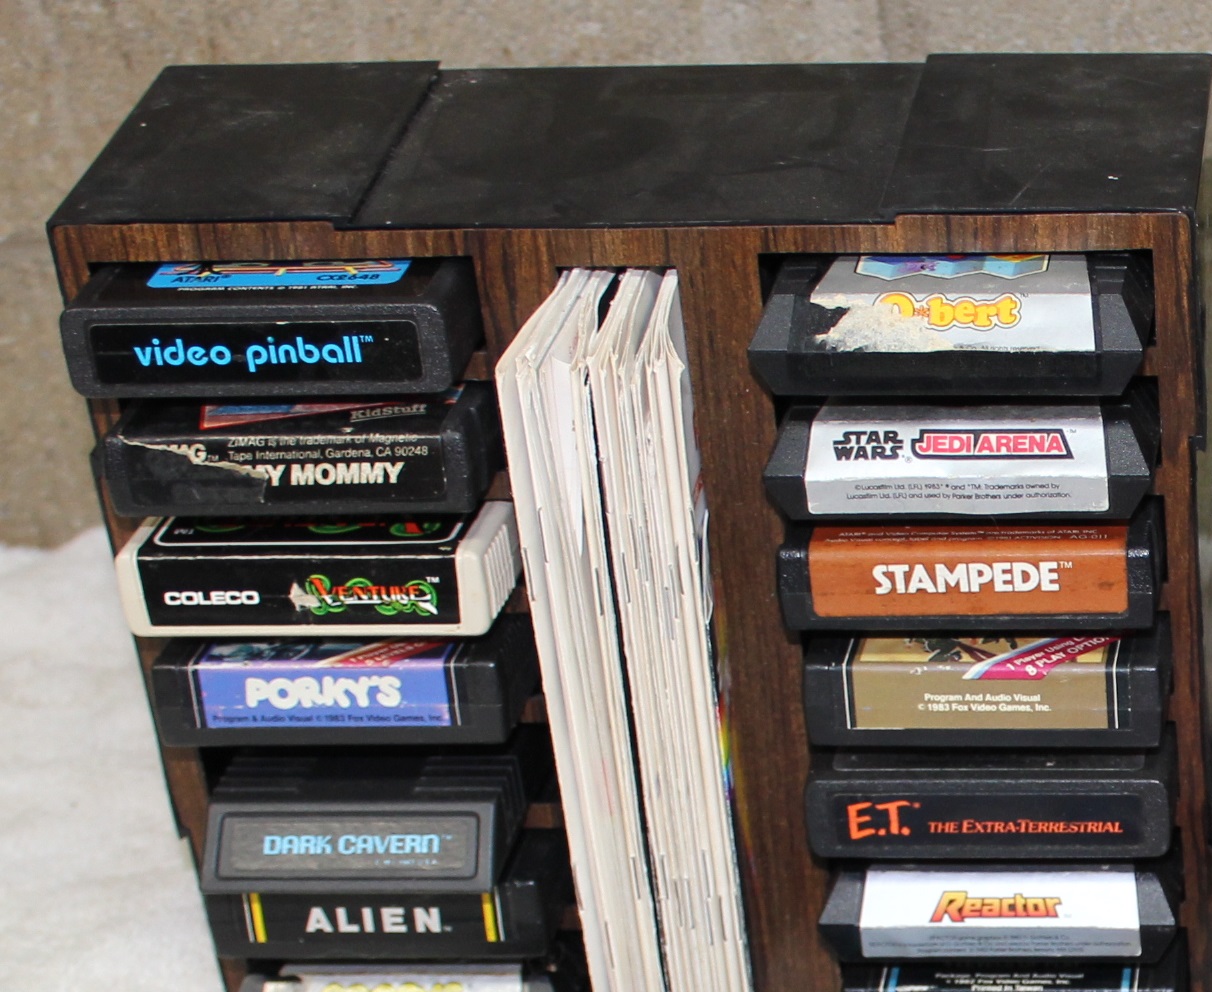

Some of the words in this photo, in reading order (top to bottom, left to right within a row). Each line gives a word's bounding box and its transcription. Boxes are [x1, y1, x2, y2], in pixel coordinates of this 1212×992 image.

[134, 338, 232, 366] video
[350, 404, 426, 421] KidStuff
[834, 430, 903, 445] STAR
[915, 433, 972, 454] JEDI
[977, 433, 1065, 454] ARENA
[375, 447, 392, 457] CA
[395, 445, 428, 456] 90248
[833, 446, 904, 460] WARS
[291, 462, 404, 485] MOMMY
[164, 591, 260, 604] COLECO
[245, 676, 401, 709] PORKY'S
[924, 693, 963, 702] Program
[965, 693, 983, 702] And
[985, 693, 1012, 702] Audio
[1013, 693, 1040, 702] Visual
[928, 821, 960, 834] THE
[962, 819, 1123, 834] EXTRA-TERRESTRIAL
[263, 834, 331, 855] DARK
[929, 891, 1062, 923] Reactor
[306, 907, 443, 933] ALIEN
